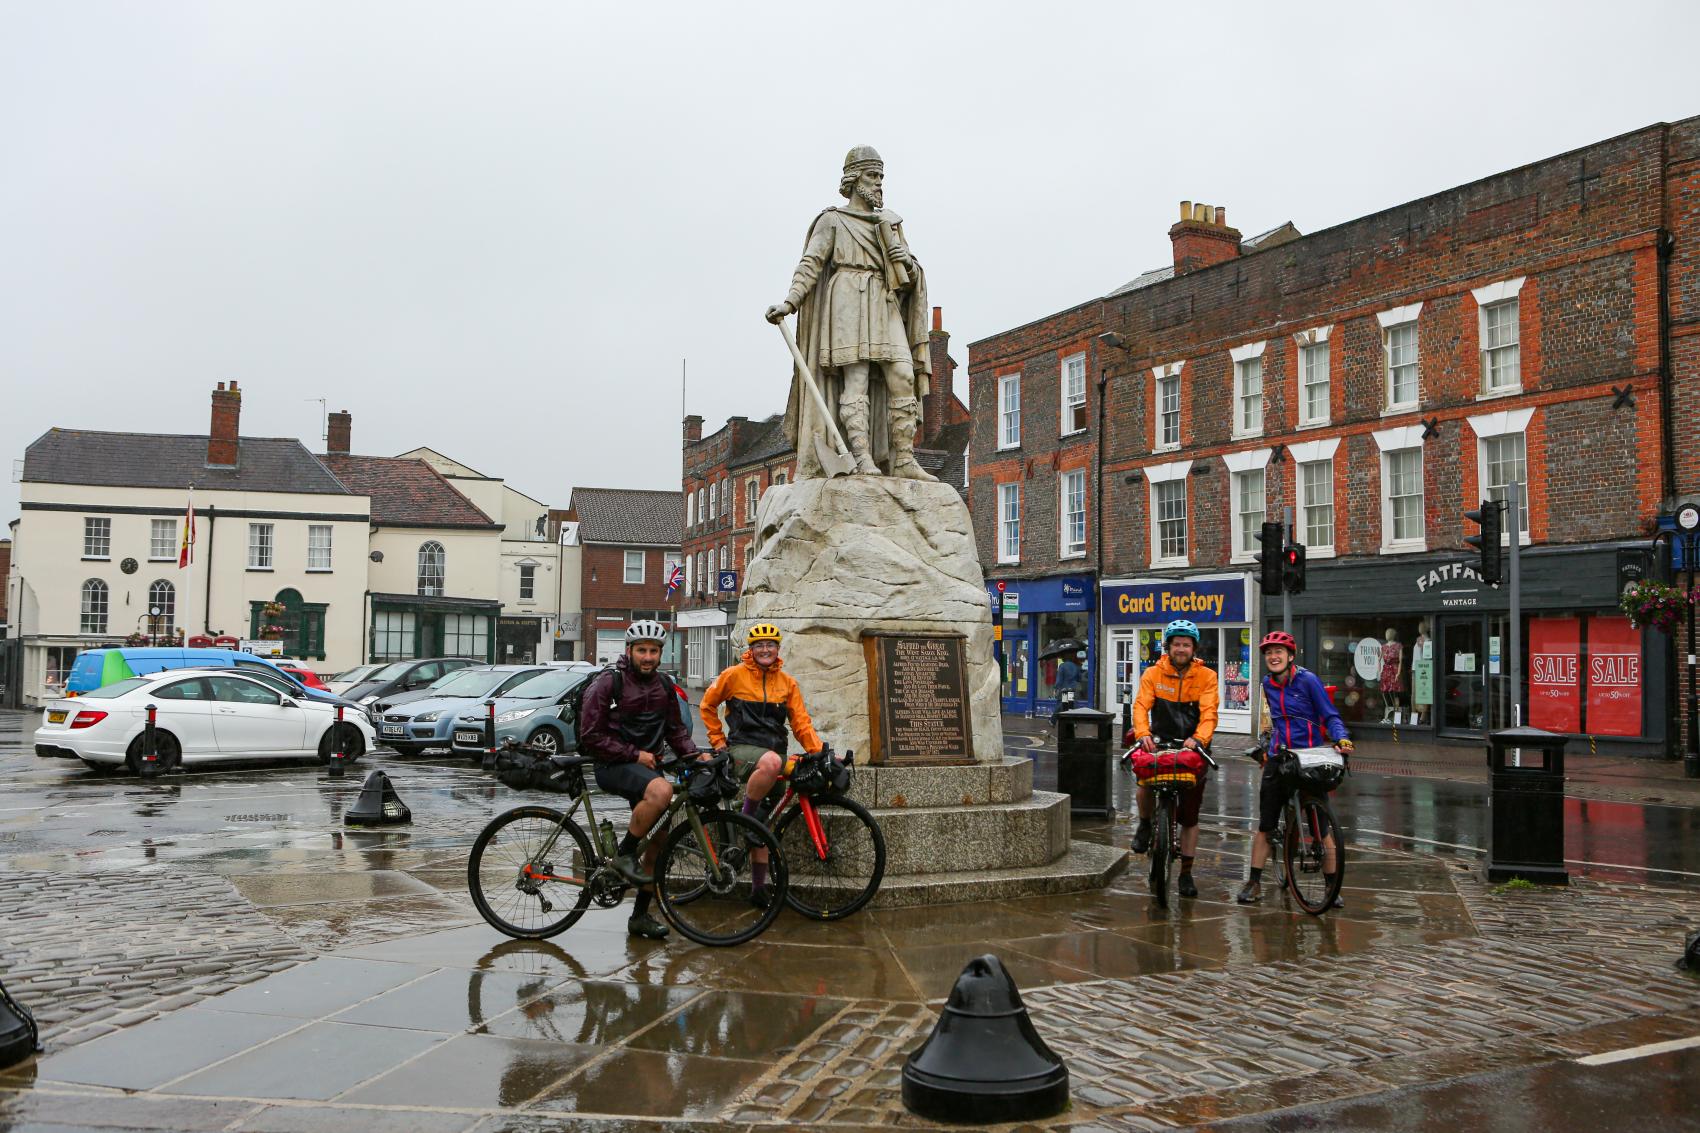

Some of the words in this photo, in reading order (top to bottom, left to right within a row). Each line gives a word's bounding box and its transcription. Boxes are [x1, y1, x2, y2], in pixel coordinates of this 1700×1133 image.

[1417, 563, 1499, 592] FATFA
[1118, 594, 1155, 614] Card
[1161, 591, 1225, 616] Factory
[1442, 598, 1477, 606] WANTAGE
[1363, 655, 1376, 665] YOU
[1533, 656, 1577, 683] SALE
[1591, 657, 1639, 683] SALE
